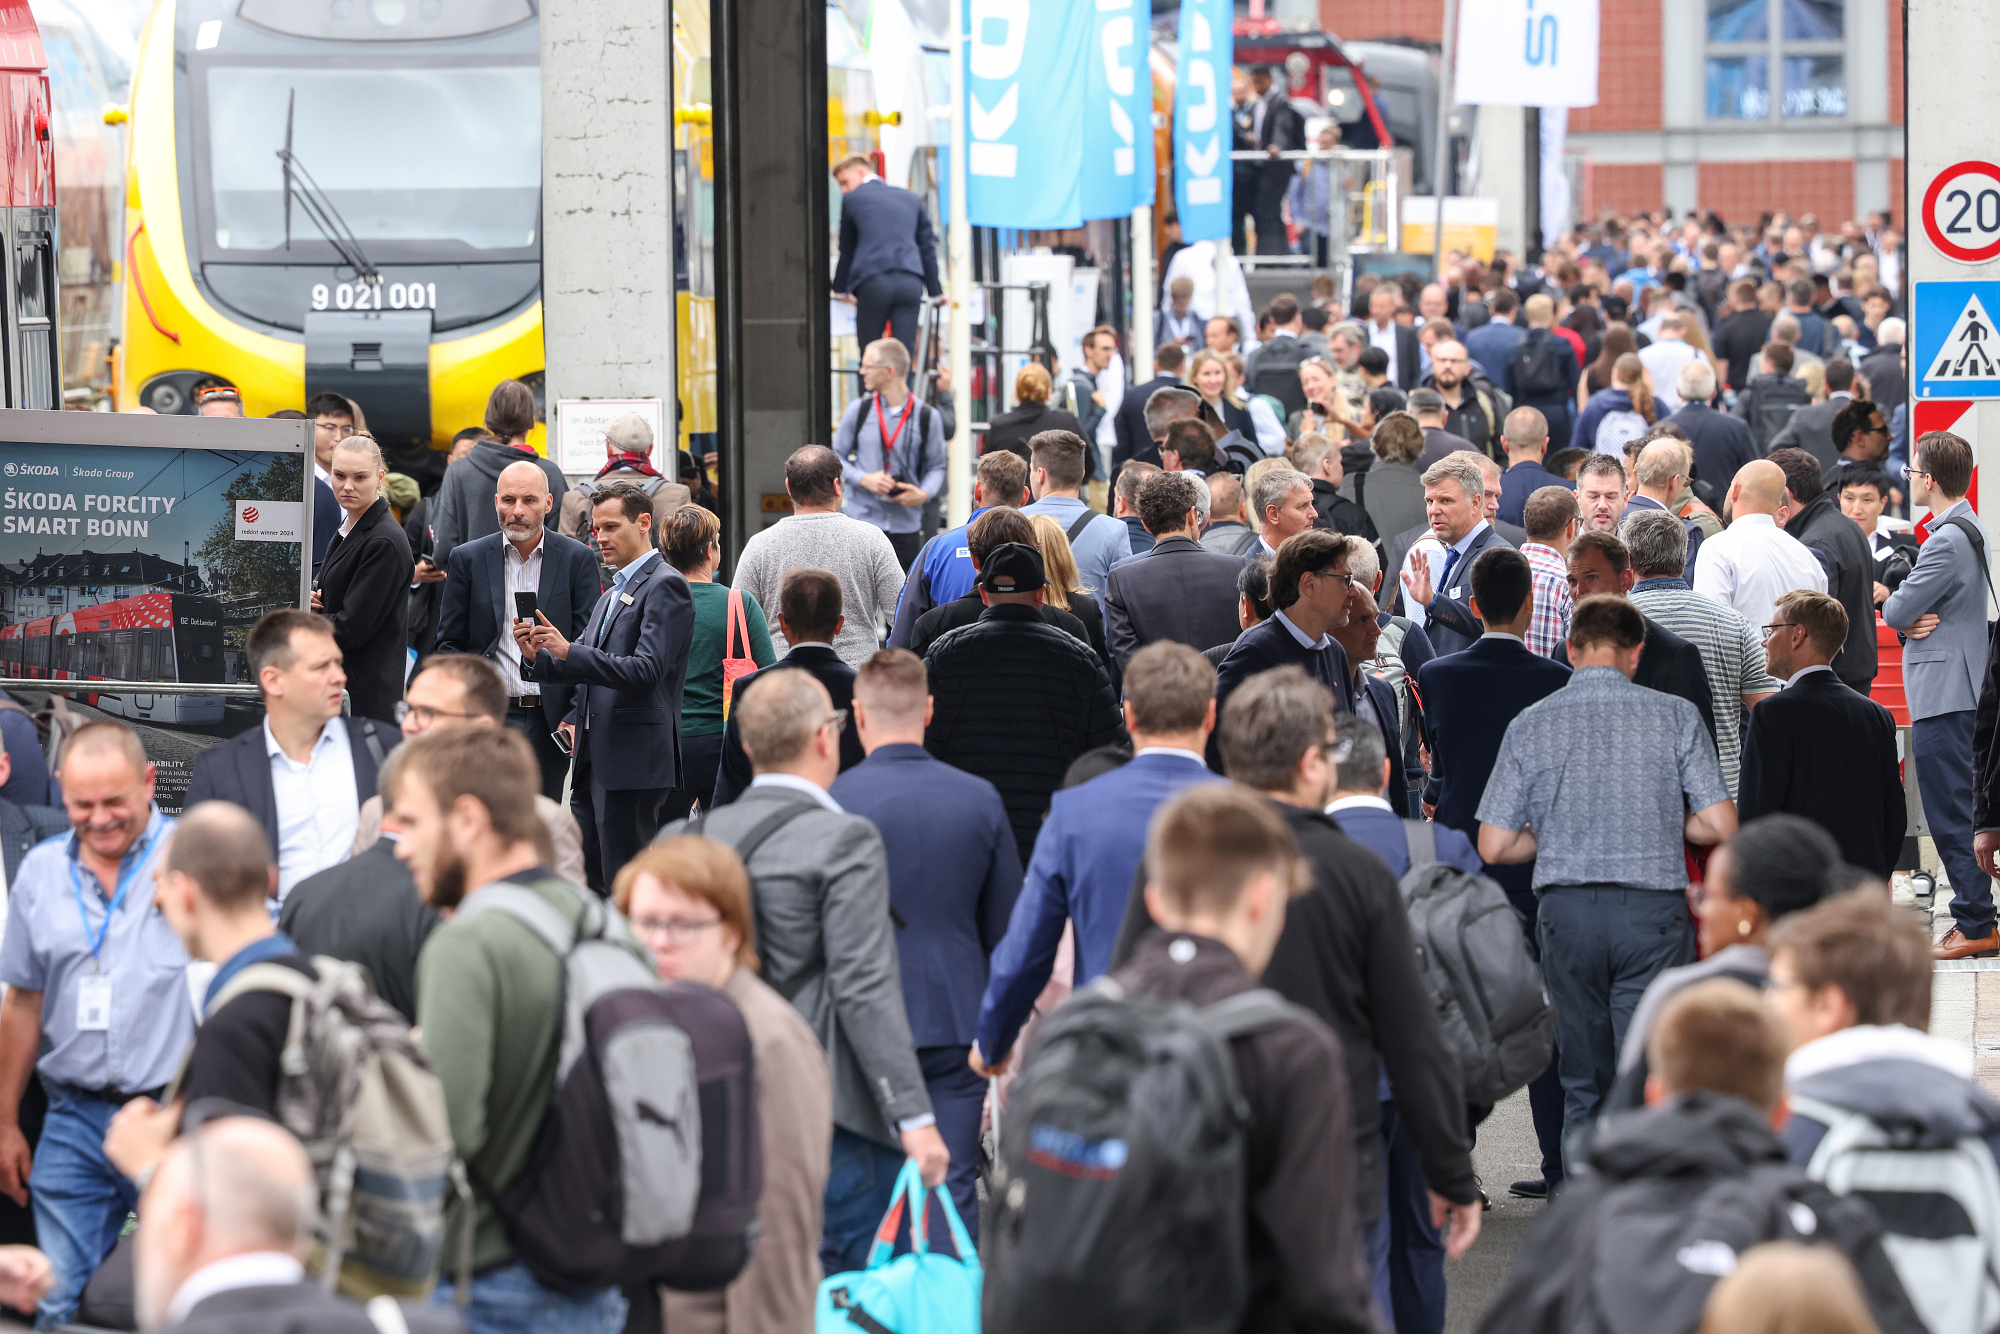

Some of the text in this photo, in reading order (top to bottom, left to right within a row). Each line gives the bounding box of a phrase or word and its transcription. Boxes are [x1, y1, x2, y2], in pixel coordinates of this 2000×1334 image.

[1946, 189, 2000, 233] 20
[312, 282, 436, 311] 9 021 001
[20, 463, 134, 480] ŠKODA Škoda Group
[4, 487, 176, 514] ŠKODA FORCITY
[3, 516, 149, 538] SMART BONN
